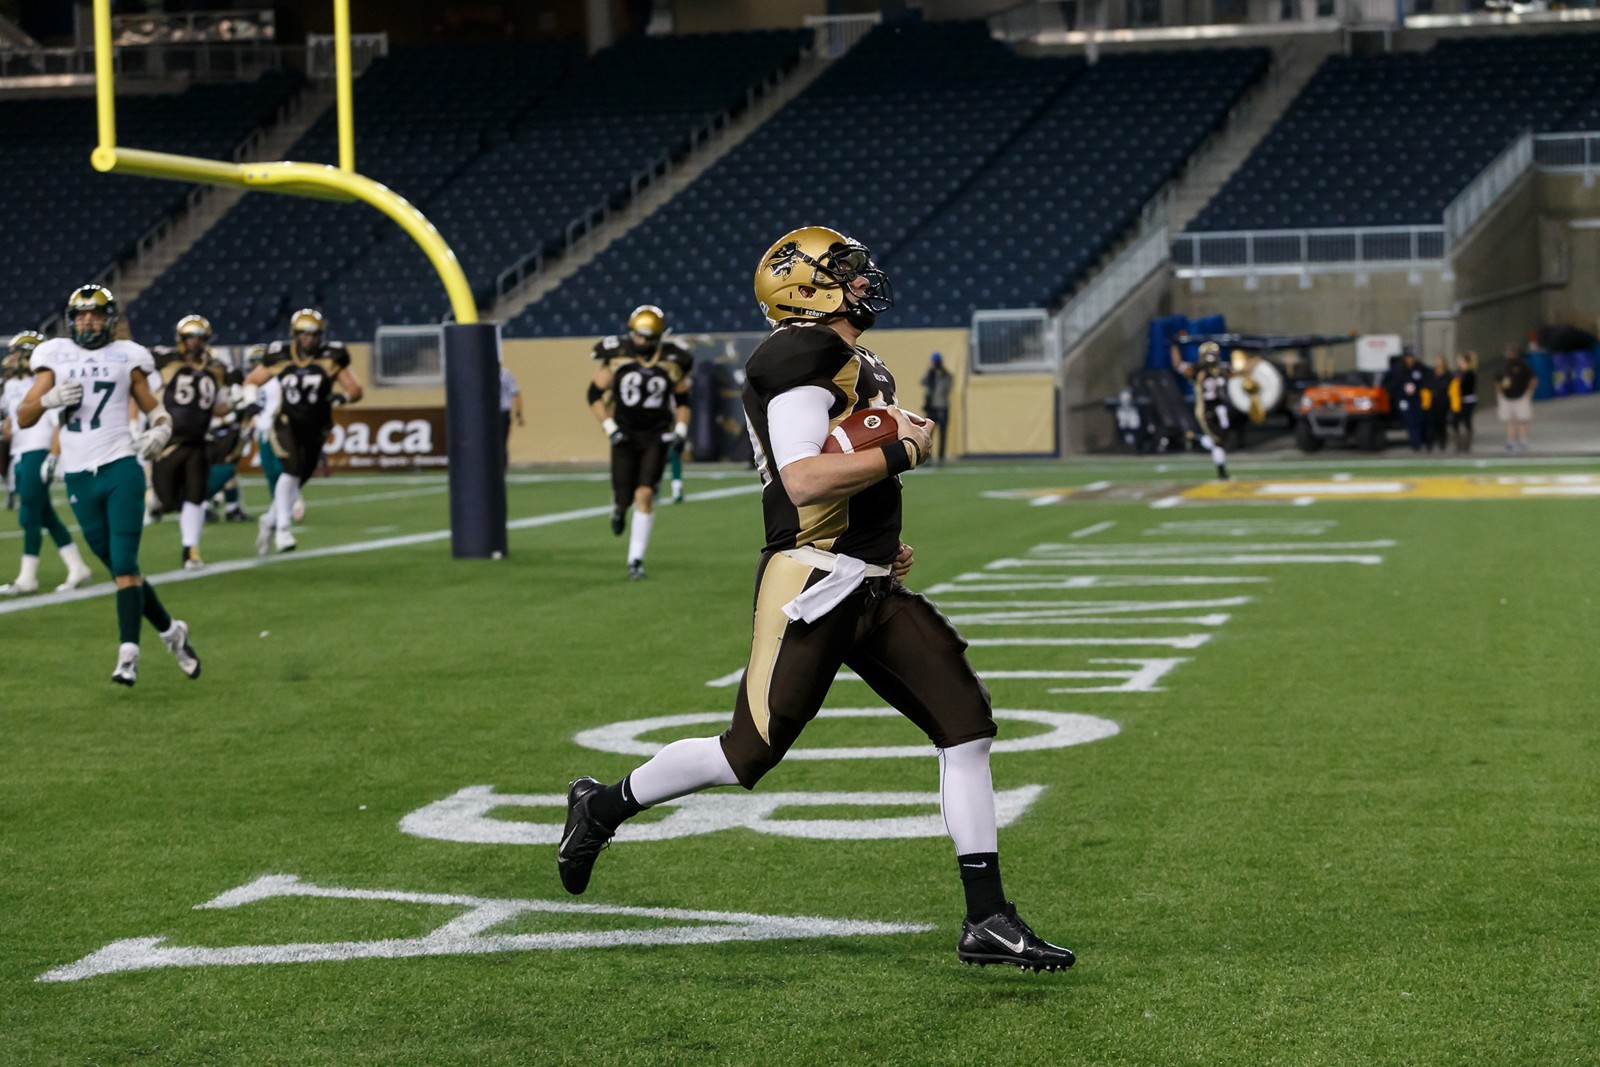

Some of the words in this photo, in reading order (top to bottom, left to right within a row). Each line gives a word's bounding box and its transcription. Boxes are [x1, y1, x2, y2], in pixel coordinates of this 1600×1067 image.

[69, 366, 110, 378] RAMS
[620, 371, 667, 408] 62
[174, 374, 216, 410] 59
